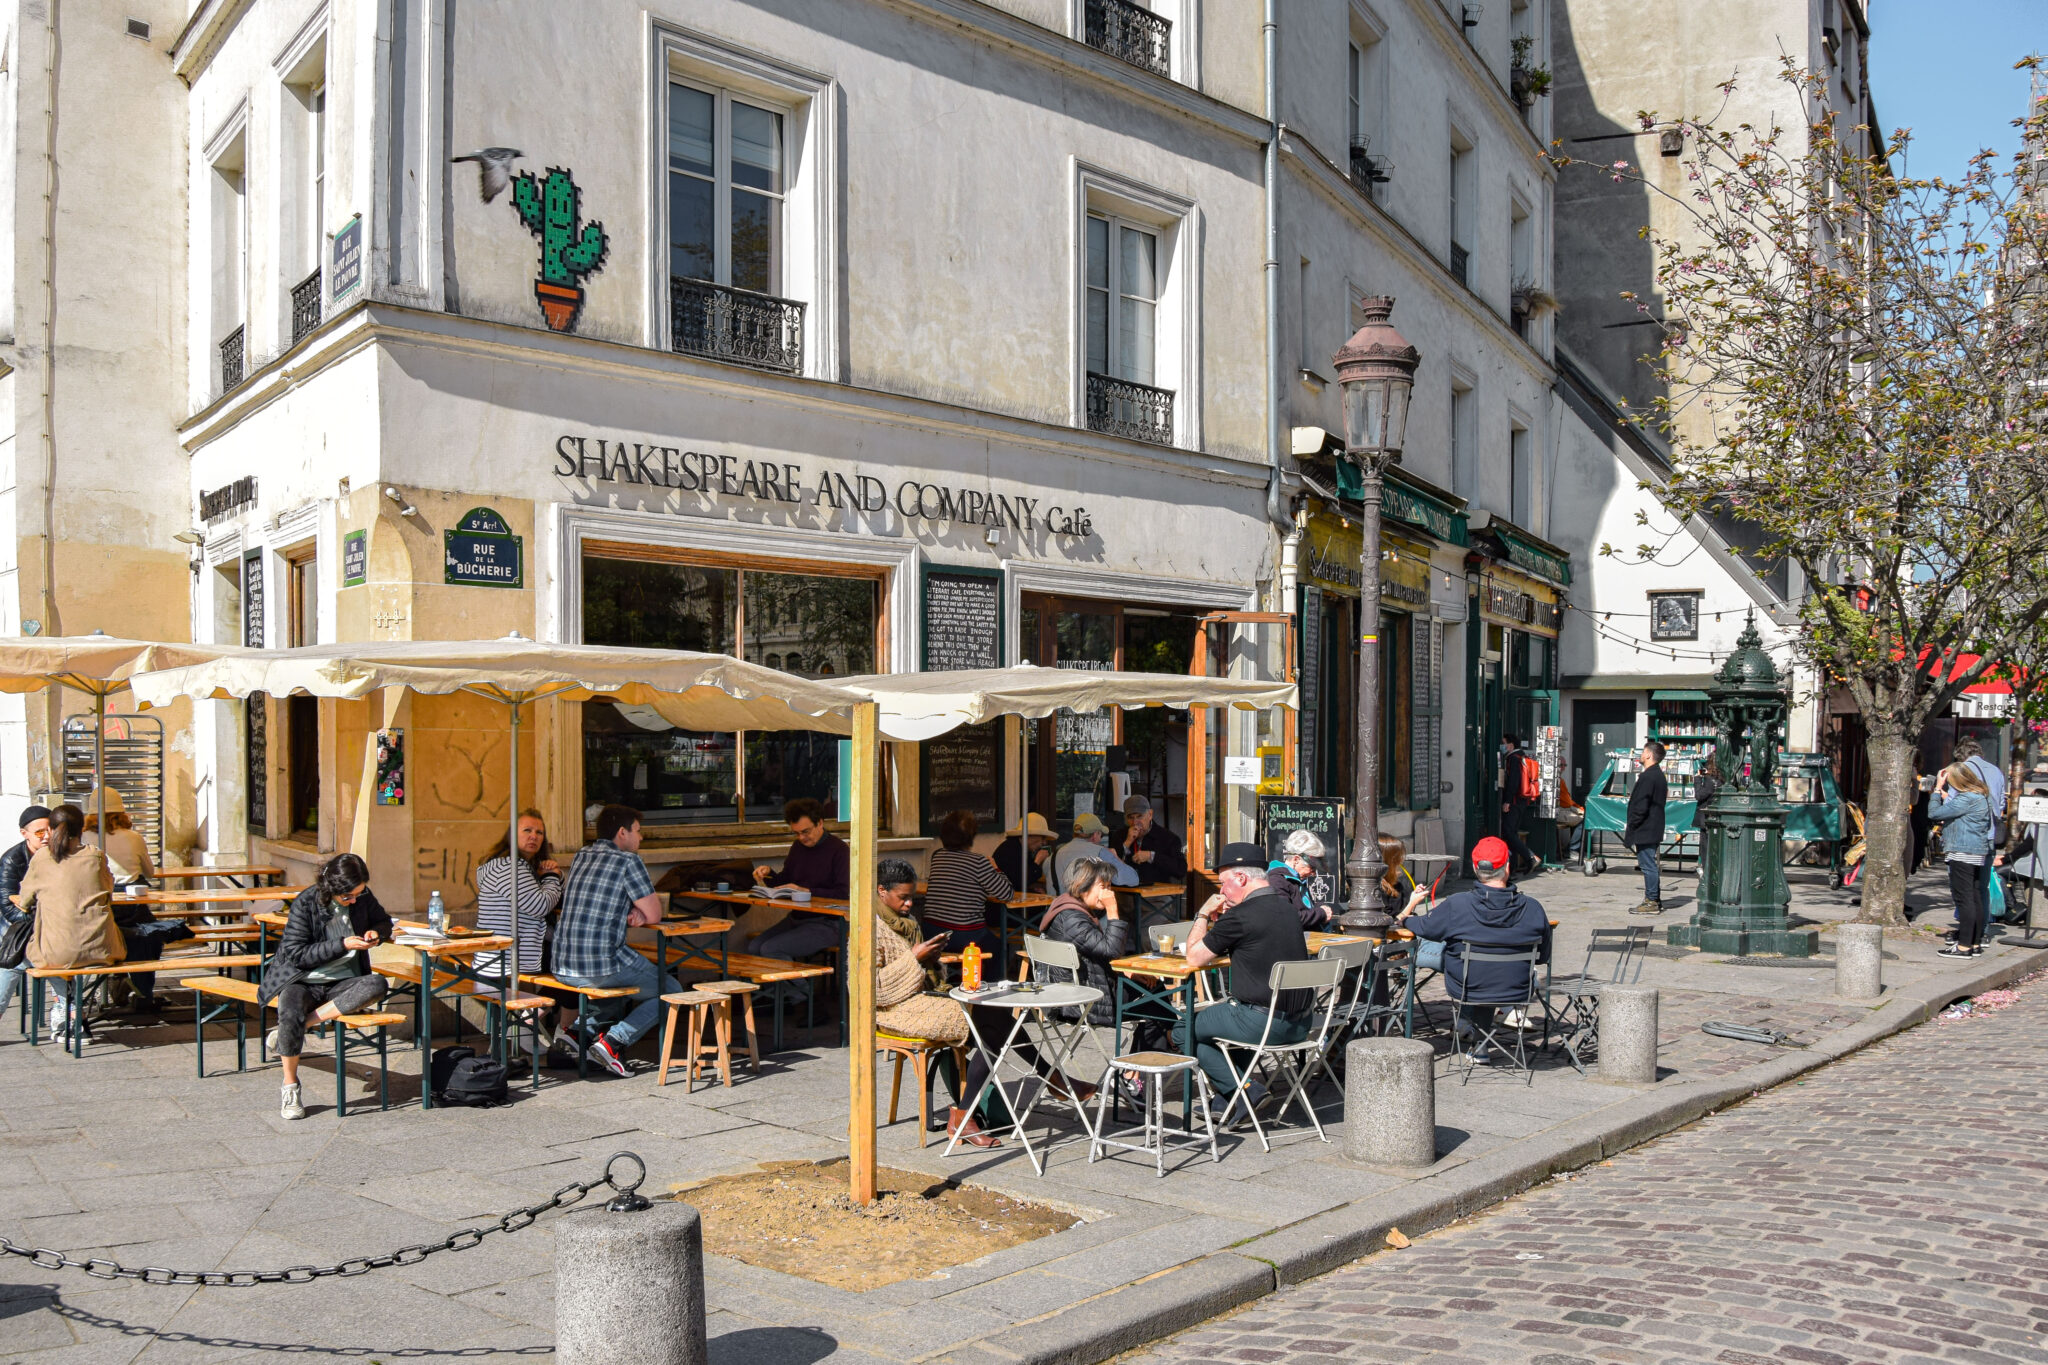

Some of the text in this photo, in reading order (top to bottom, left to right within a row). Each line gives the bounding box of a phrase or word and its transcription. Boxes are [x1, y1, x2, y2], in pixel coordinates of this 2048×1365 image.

[554, 436, 1092, 537] SHAKESPEARE AND COMPANY Café
[473, 544, 495, 555] RUE
[457, 562, 512, 577] BÛCHERIE
[1597, 732, 1604, 744] 9
[1268, 804, 1334, 822] Shakespeare &
